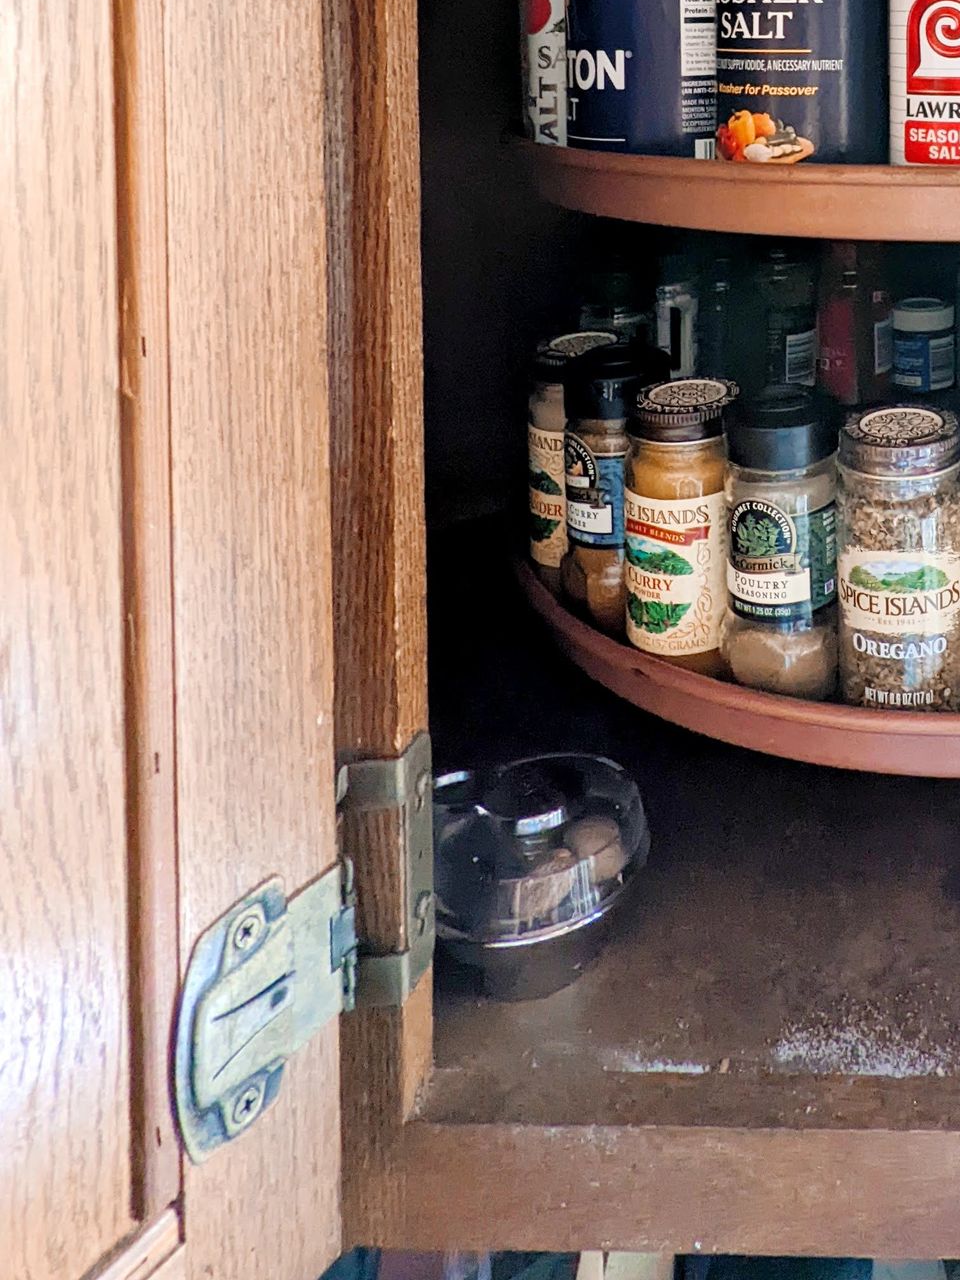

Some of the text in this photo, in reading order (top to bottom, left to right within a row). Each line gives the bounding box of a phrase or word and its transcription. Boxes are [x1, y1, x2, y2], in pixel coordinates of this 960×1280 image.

[721, 12, 793, 39] SALT
[773, 60, 811, 71] NECESSARY
[812, 60, 843, 70] NUTRIENT
[745, 84, 760, 95] for
[761, 84, 818, 95] Passover
[569, 504, 599, 520] CURRY
[638, 504, 709, 525] ISLANDS
[732, 503, 751, 532] GOURMET
[752, 502, 791, 538] COLLECTION
[649, 528, 686, 543] BLENDS
[628, 567, 673, 592] CURRY
[734, 571, 788, 590] POULTRY
[736, 584, 787, 599] SEASONING
[840, 578, 960, 617] SPICE ISLANDS
[853, 632, 948, 659] OREGANO
[865, 686, 876, 701] NET
[877, 689, 889, 704] WT
[902, 691, 912, 705] OZ
